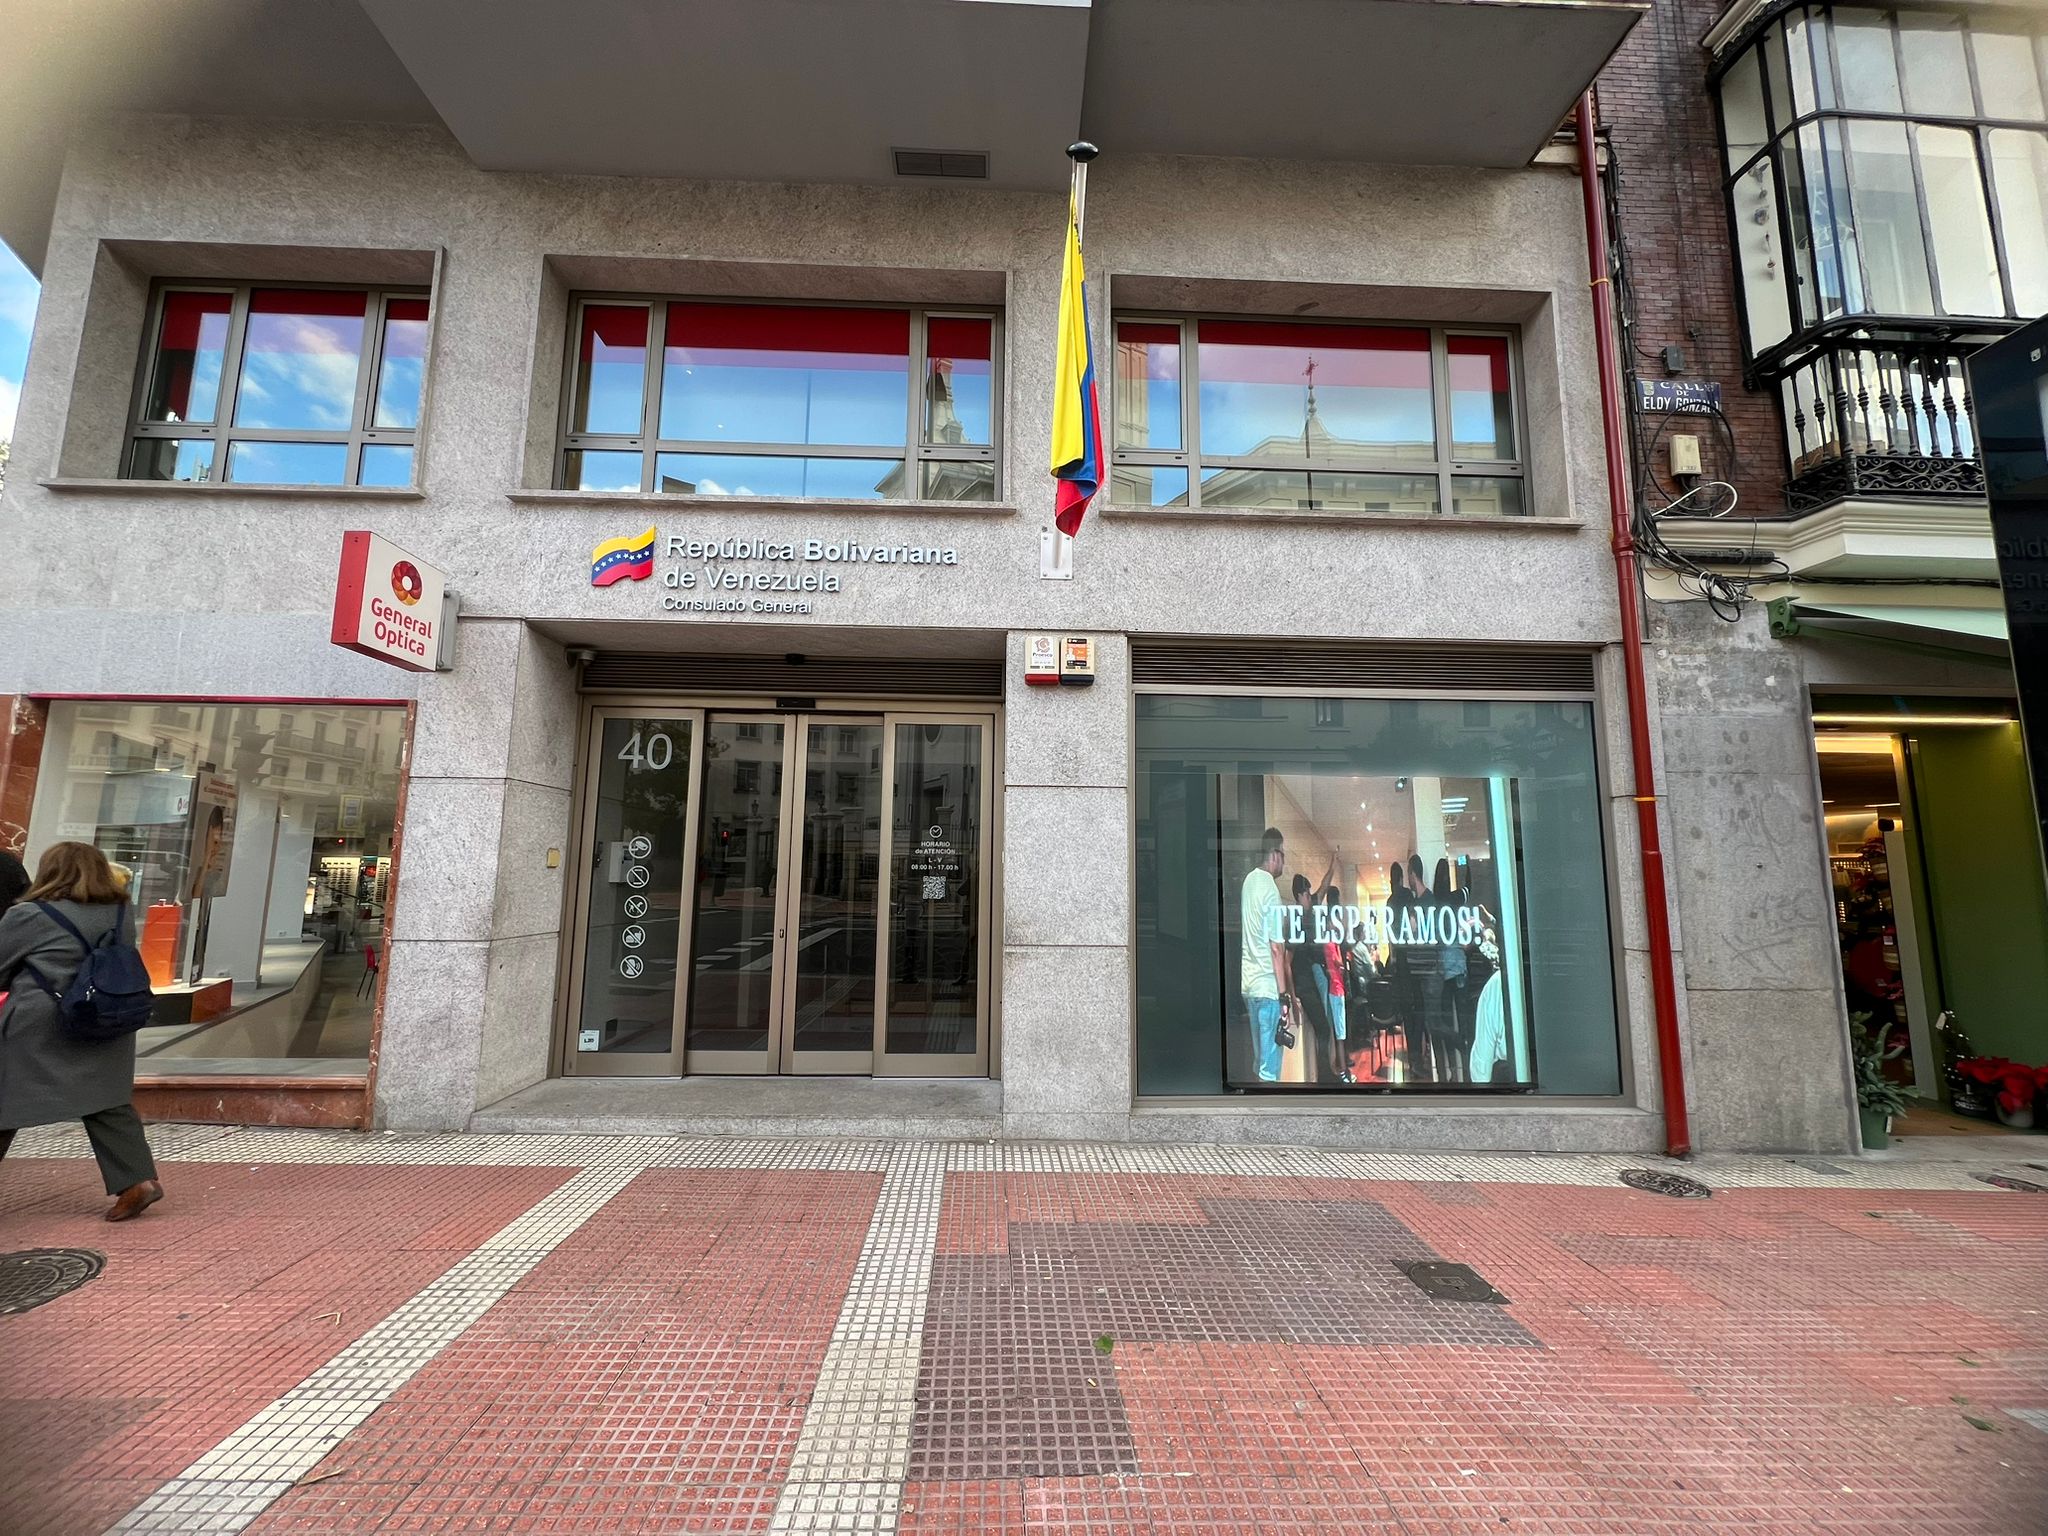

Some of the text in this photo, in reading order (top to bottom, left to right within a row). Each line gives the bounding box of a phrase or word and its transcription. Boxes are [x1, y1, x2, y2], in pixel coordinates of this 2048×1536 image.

[1643, 396, 1671, 410] ELOY
[666, 535, 958, 565] República Bolivariana
[664, 566, 841, 592] de Venezuela
[371, 597, 432, 639] General
[662, 597, 812, 613] Consulado General
[374, 621, 426, 657] Optica
[617, 732, 673, 770] 40
[1312, 904, 1482, 946] ESPERAMOS!
